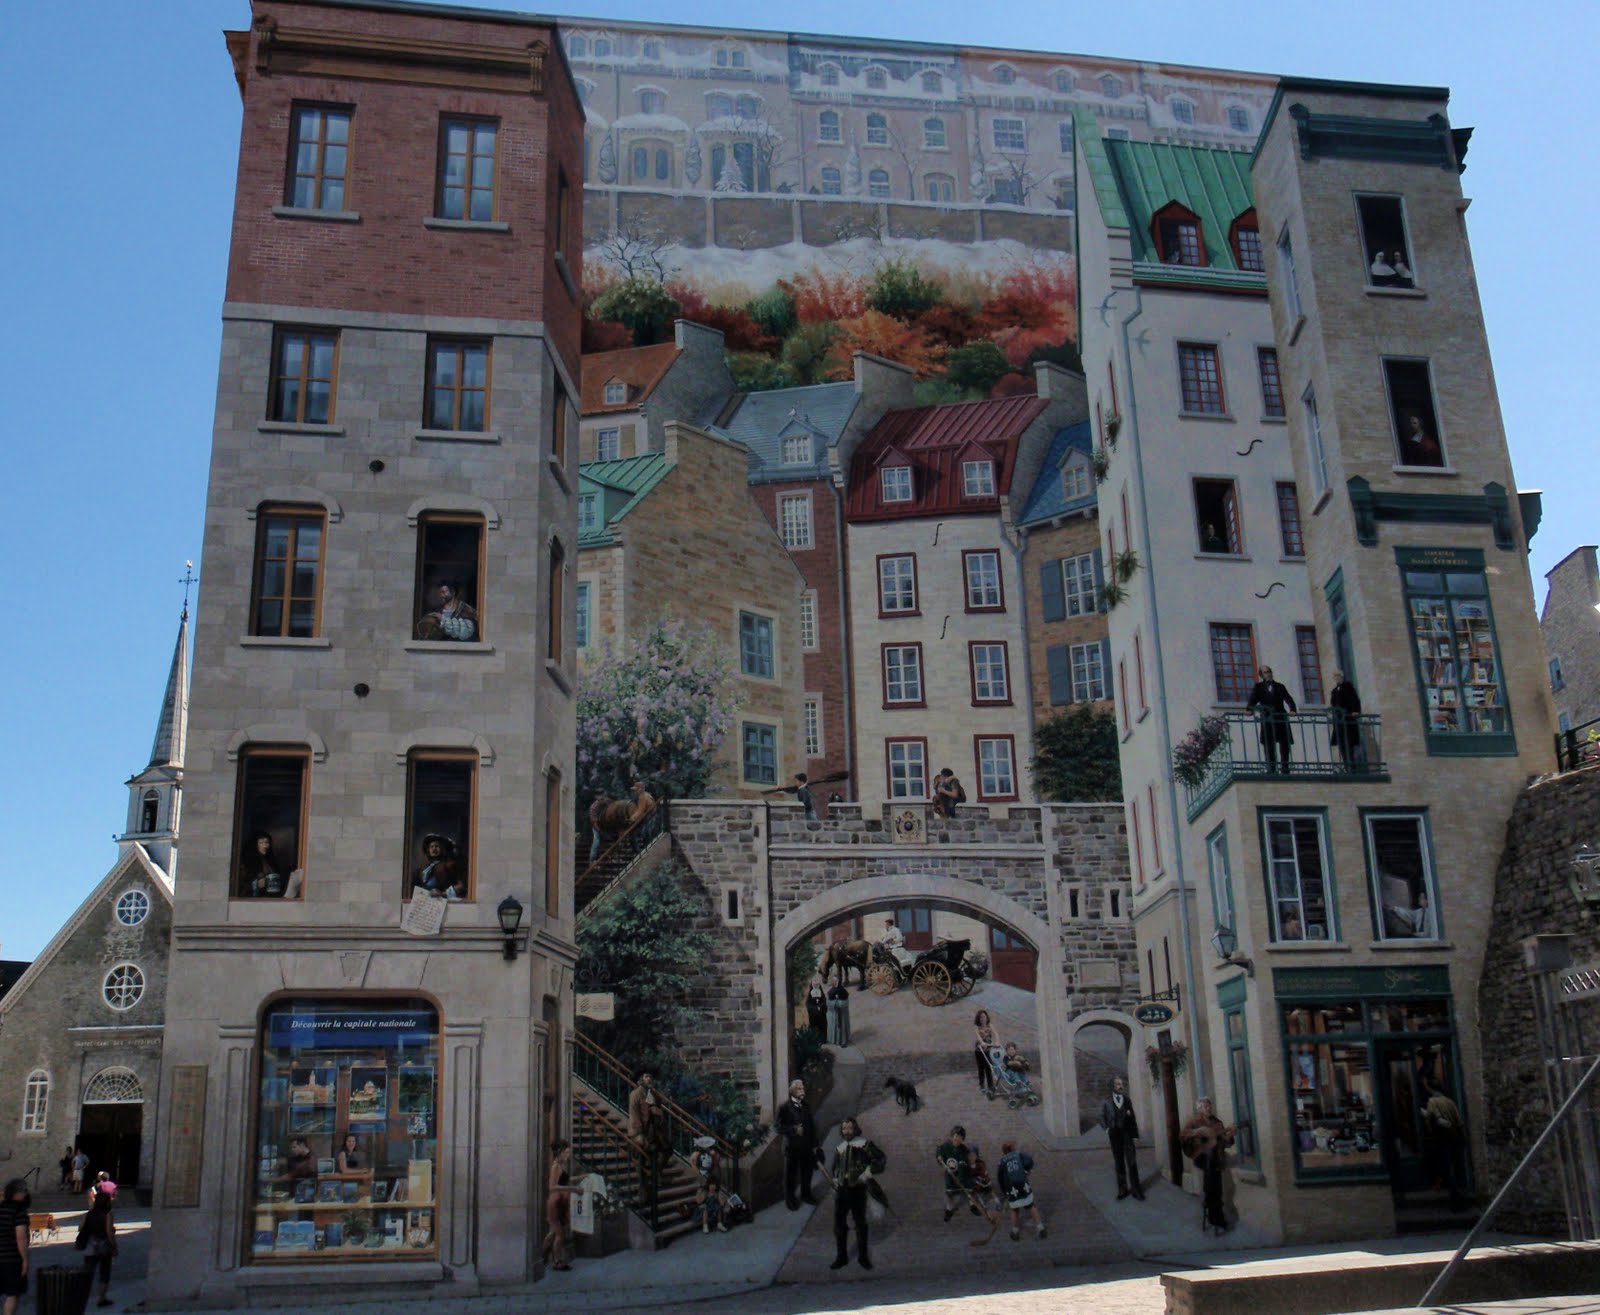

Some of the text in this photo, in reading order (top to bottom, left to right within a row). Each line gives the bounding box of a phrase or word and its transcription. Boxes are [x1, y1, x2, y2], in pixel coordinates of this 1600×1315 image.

[291, 1018, 416, 1030] Découvrir la capitale nationale
[1006, 1160, 1019, 1172] 26
